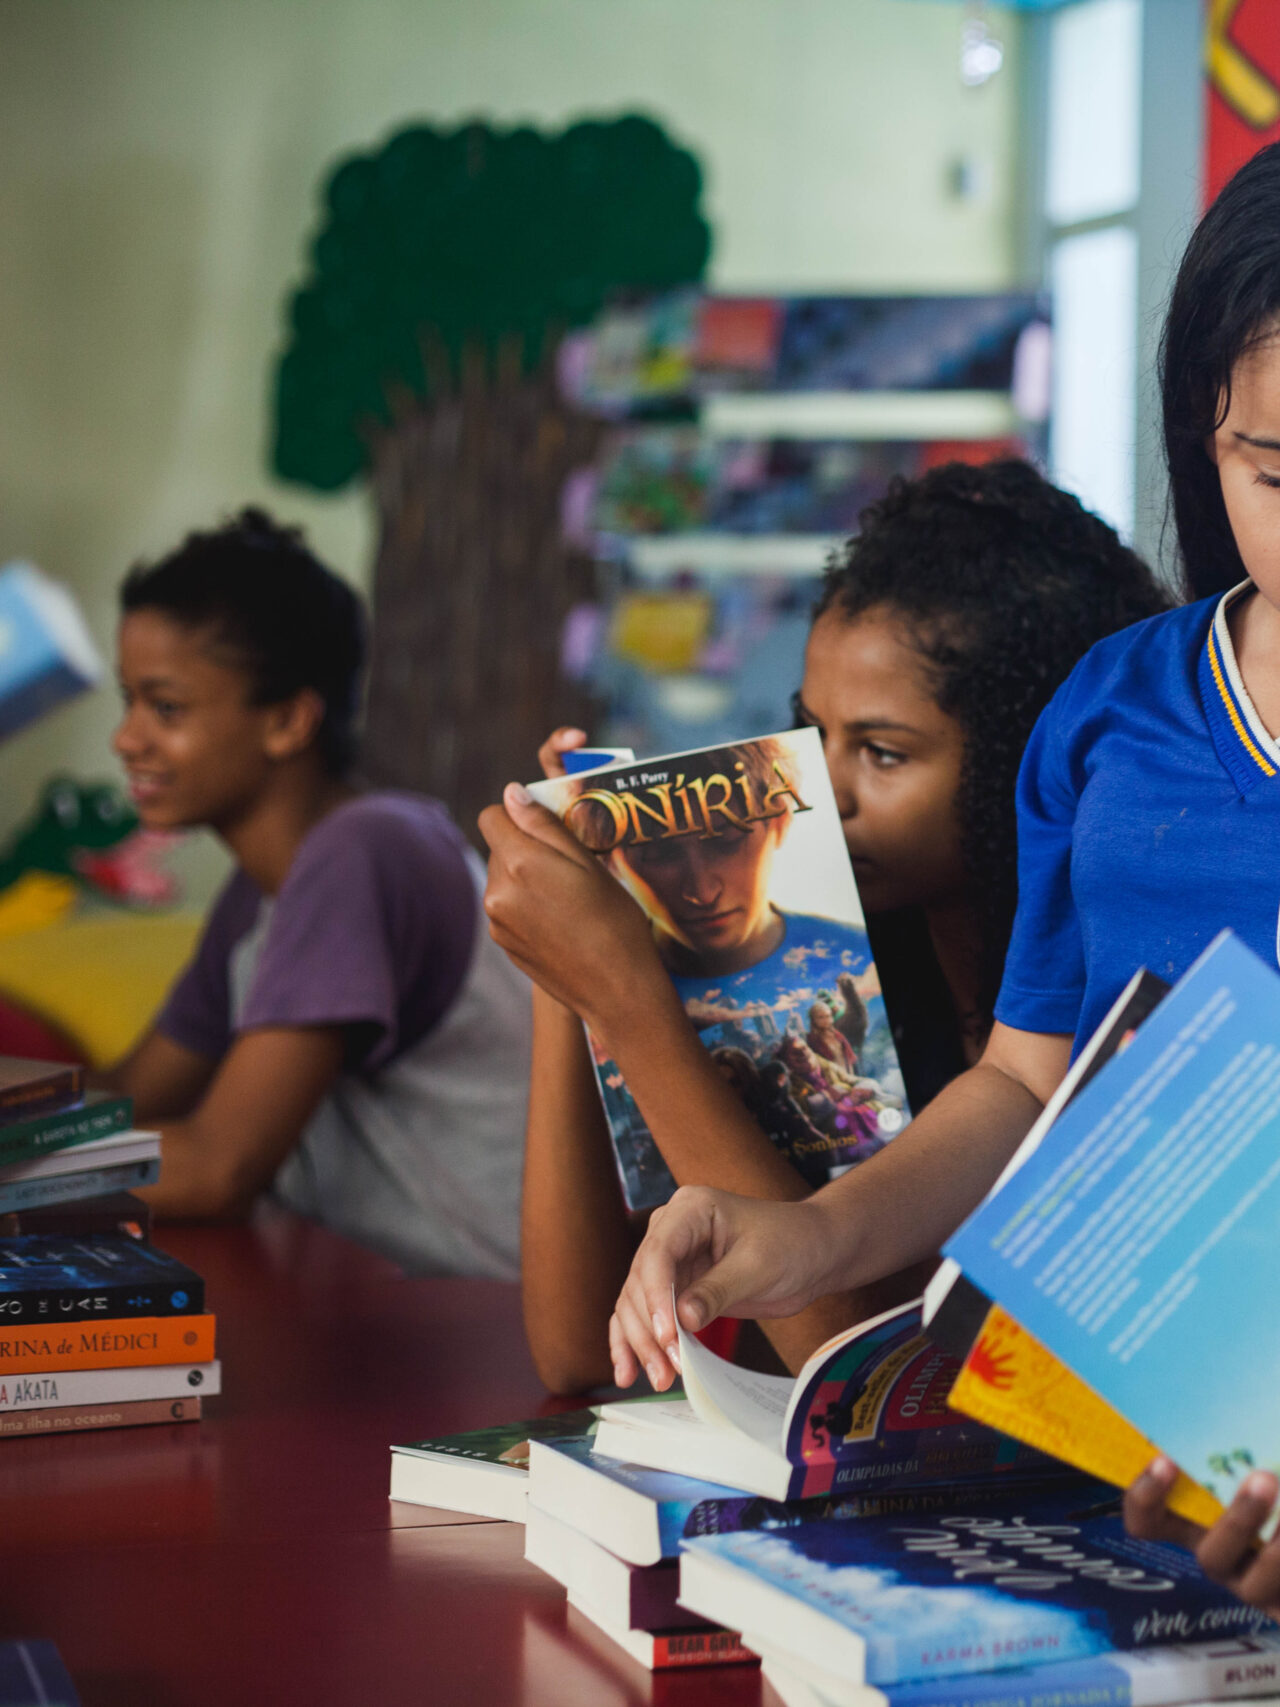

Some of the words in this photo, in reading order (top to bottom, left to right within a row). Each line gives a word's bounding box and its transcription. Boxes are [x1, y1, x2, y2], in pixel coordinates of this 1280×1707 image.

[57, 1338, 73, 1355] de
[79, 1332, 158, 1352] MÉDICI
[14, 1379, 59, 1405] AKATA
[27, 1415, 51, 1429] ilha
[54, 1418, 72, 1427] no
[75, 1413, 122, 1425] oceano
[668, 1635, 705, 1655] BEAR
[921, 1643, 985, 1667] KARMA
[993, 1635, 1060, 1657] BROWN
